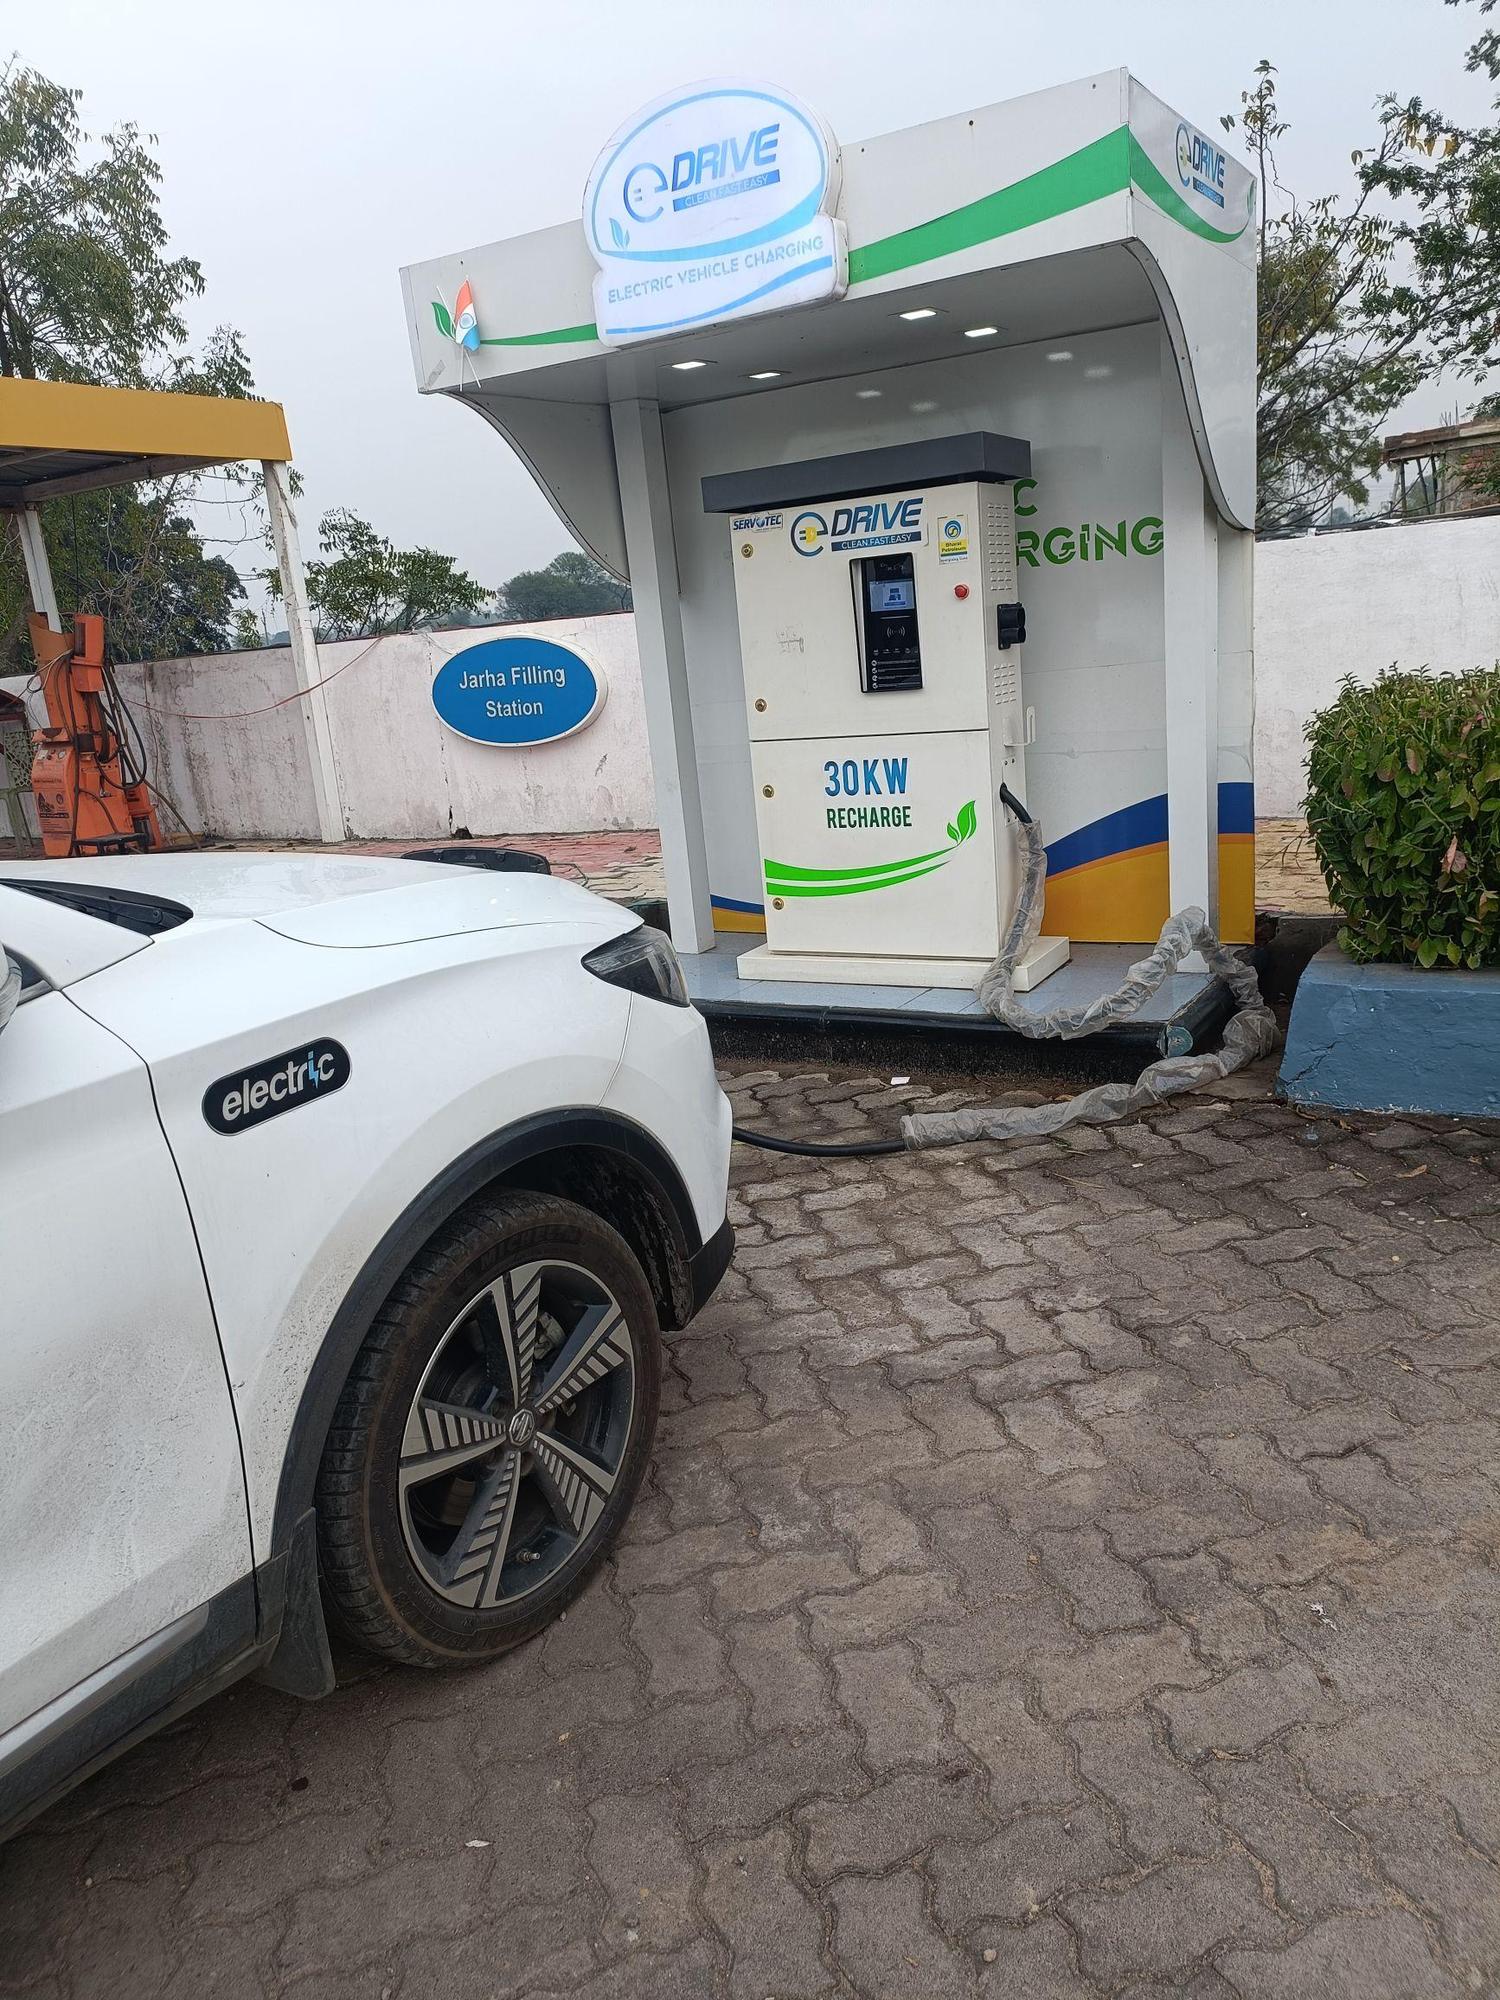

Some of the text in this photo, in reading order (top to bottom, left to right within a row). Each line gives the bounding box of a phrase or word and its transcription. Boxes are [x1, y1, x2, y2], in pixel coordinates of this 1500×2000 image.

[608, 235, 824, 304] ELECTRIC VEHICLE CHARGING
[733, 515, 782, 530] SERVOTEC
[460, 665, 566, 689] Jarha Filling
[485, 699, 544, 718] Station
[824, 757, 908, 797] 30KW
[826, 805, 912, 829] RECHARGE
[222, 1050, 335, 1121] electric
